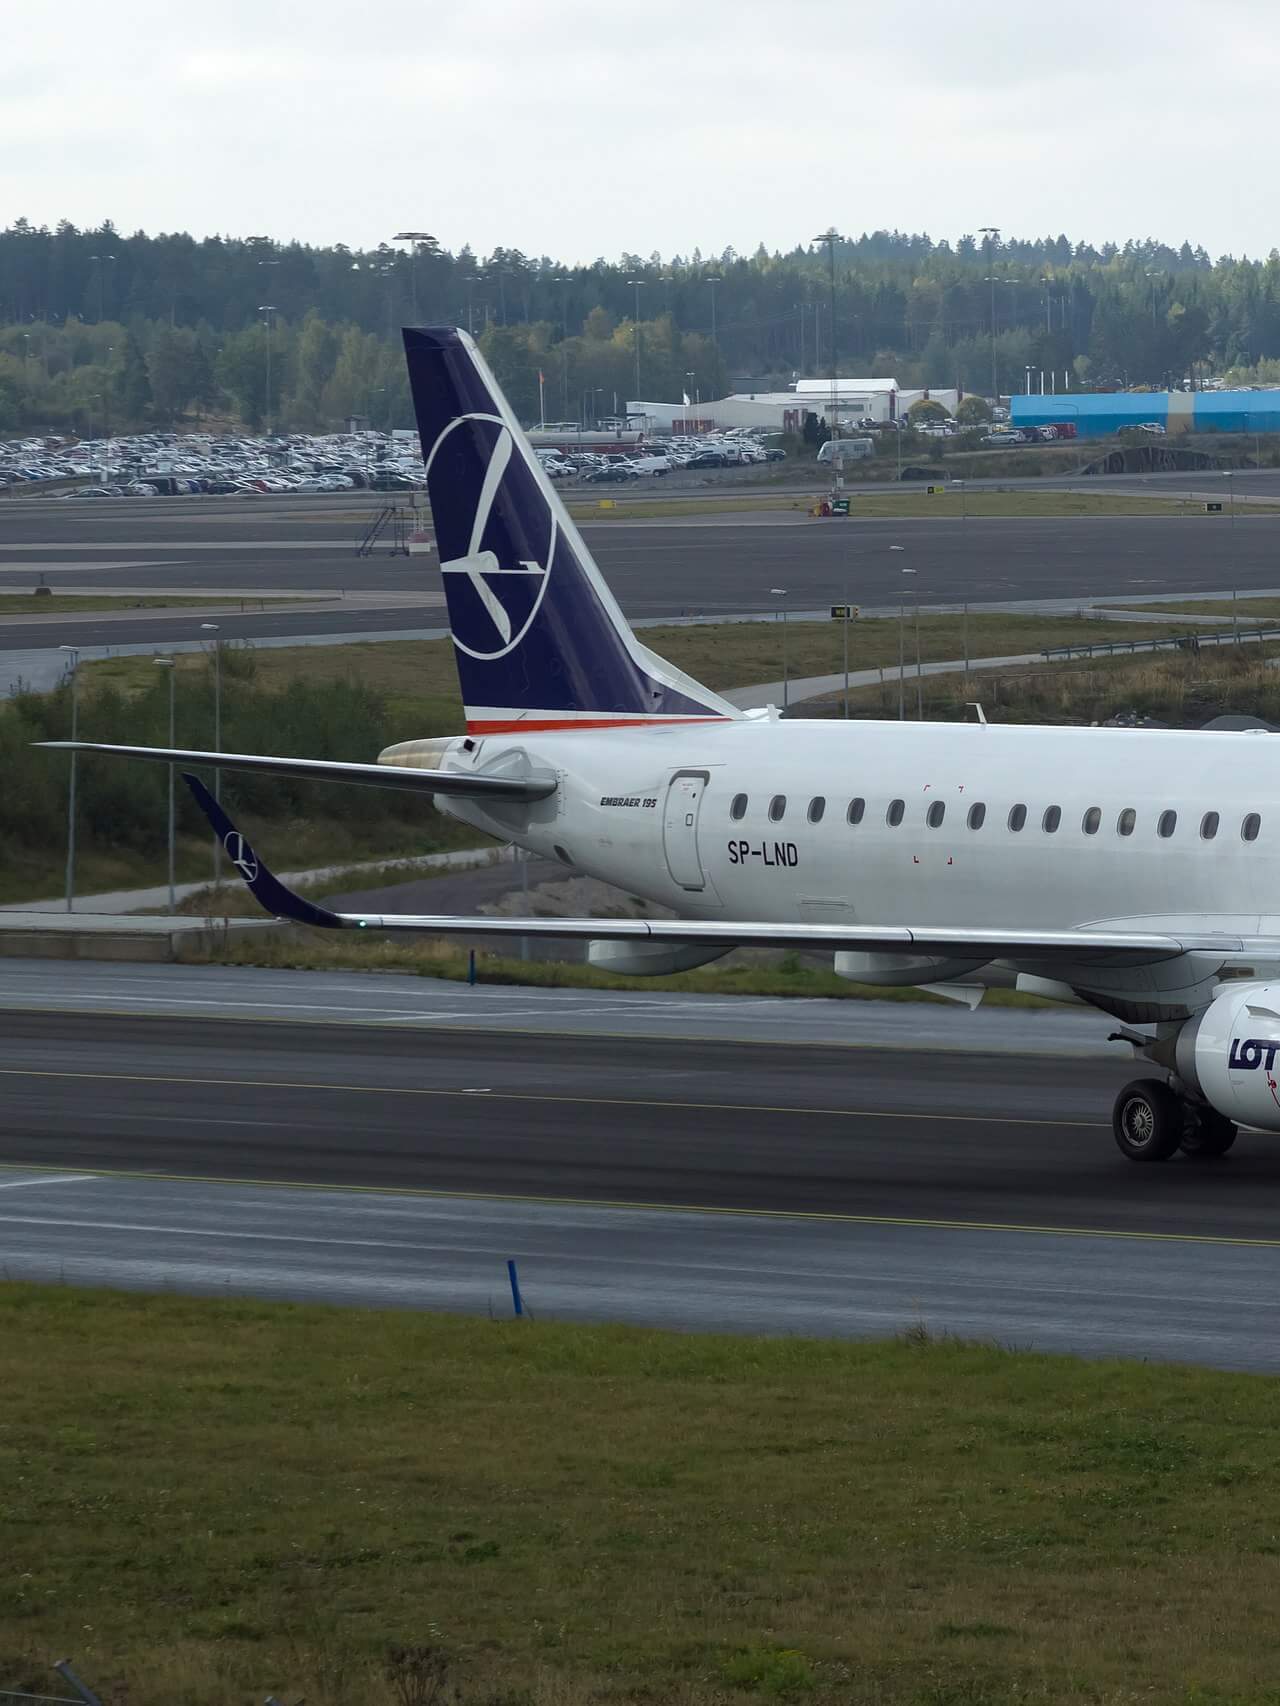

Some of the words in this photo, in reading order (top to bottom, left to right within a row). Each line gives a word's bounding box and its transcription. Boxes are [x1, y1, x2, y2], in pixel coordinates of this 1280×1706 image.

[600, 797, 641, 807] EMBRAER
[642, 798, 657, 808] 195
[728, 840, 798, 867] SP-LND
